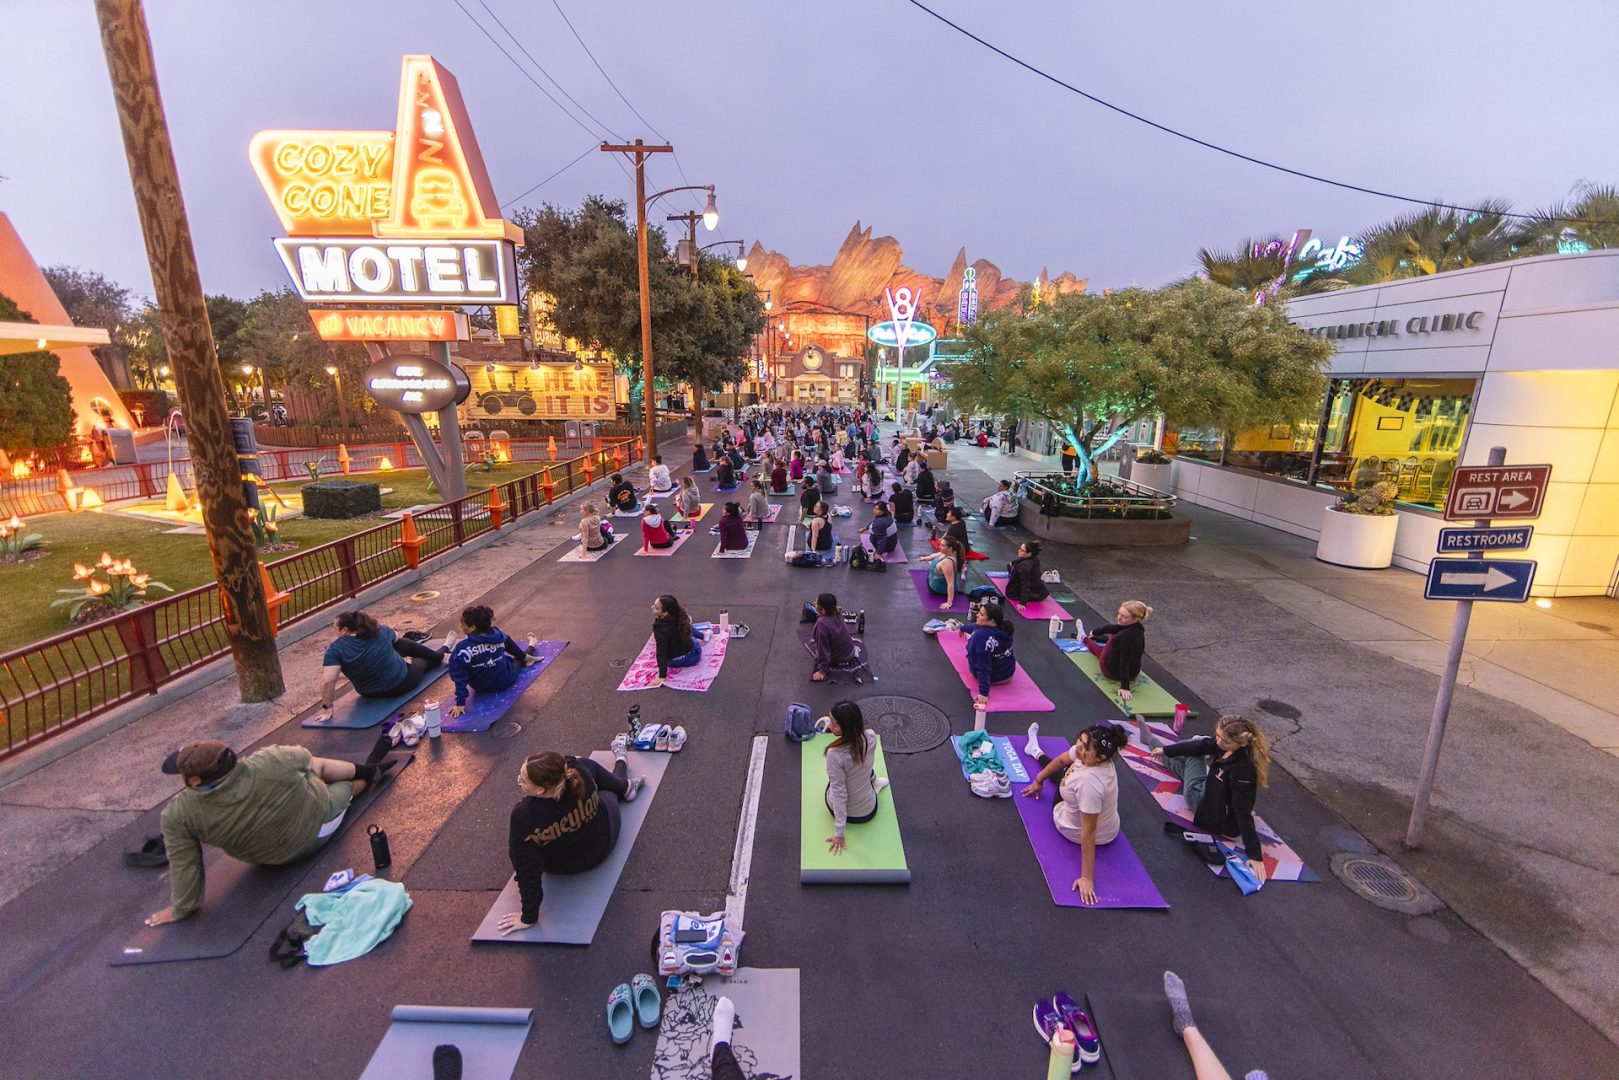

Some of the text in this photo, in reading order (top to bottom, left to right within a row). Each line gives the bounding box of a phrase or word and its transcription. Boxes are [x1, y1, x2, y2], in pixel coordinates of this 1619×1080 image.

[275, 143, 388, 178] COZY
[282, 183, 391, 218] CONE
[298, 246, 497, 293] MOTEL
[346, 315, 443, 336] VACANCY
[1406, 311, 1484, 334] CLINIC
[544, 371, 609, 391] HERE
[545, 395, 609, 414] IT IS
[1469, 472, 1532, 483] REST AREA
[1447, 533, 1524, 546] RESTROOMS
[1002, 741, 1027, 778] YOGA DAY
